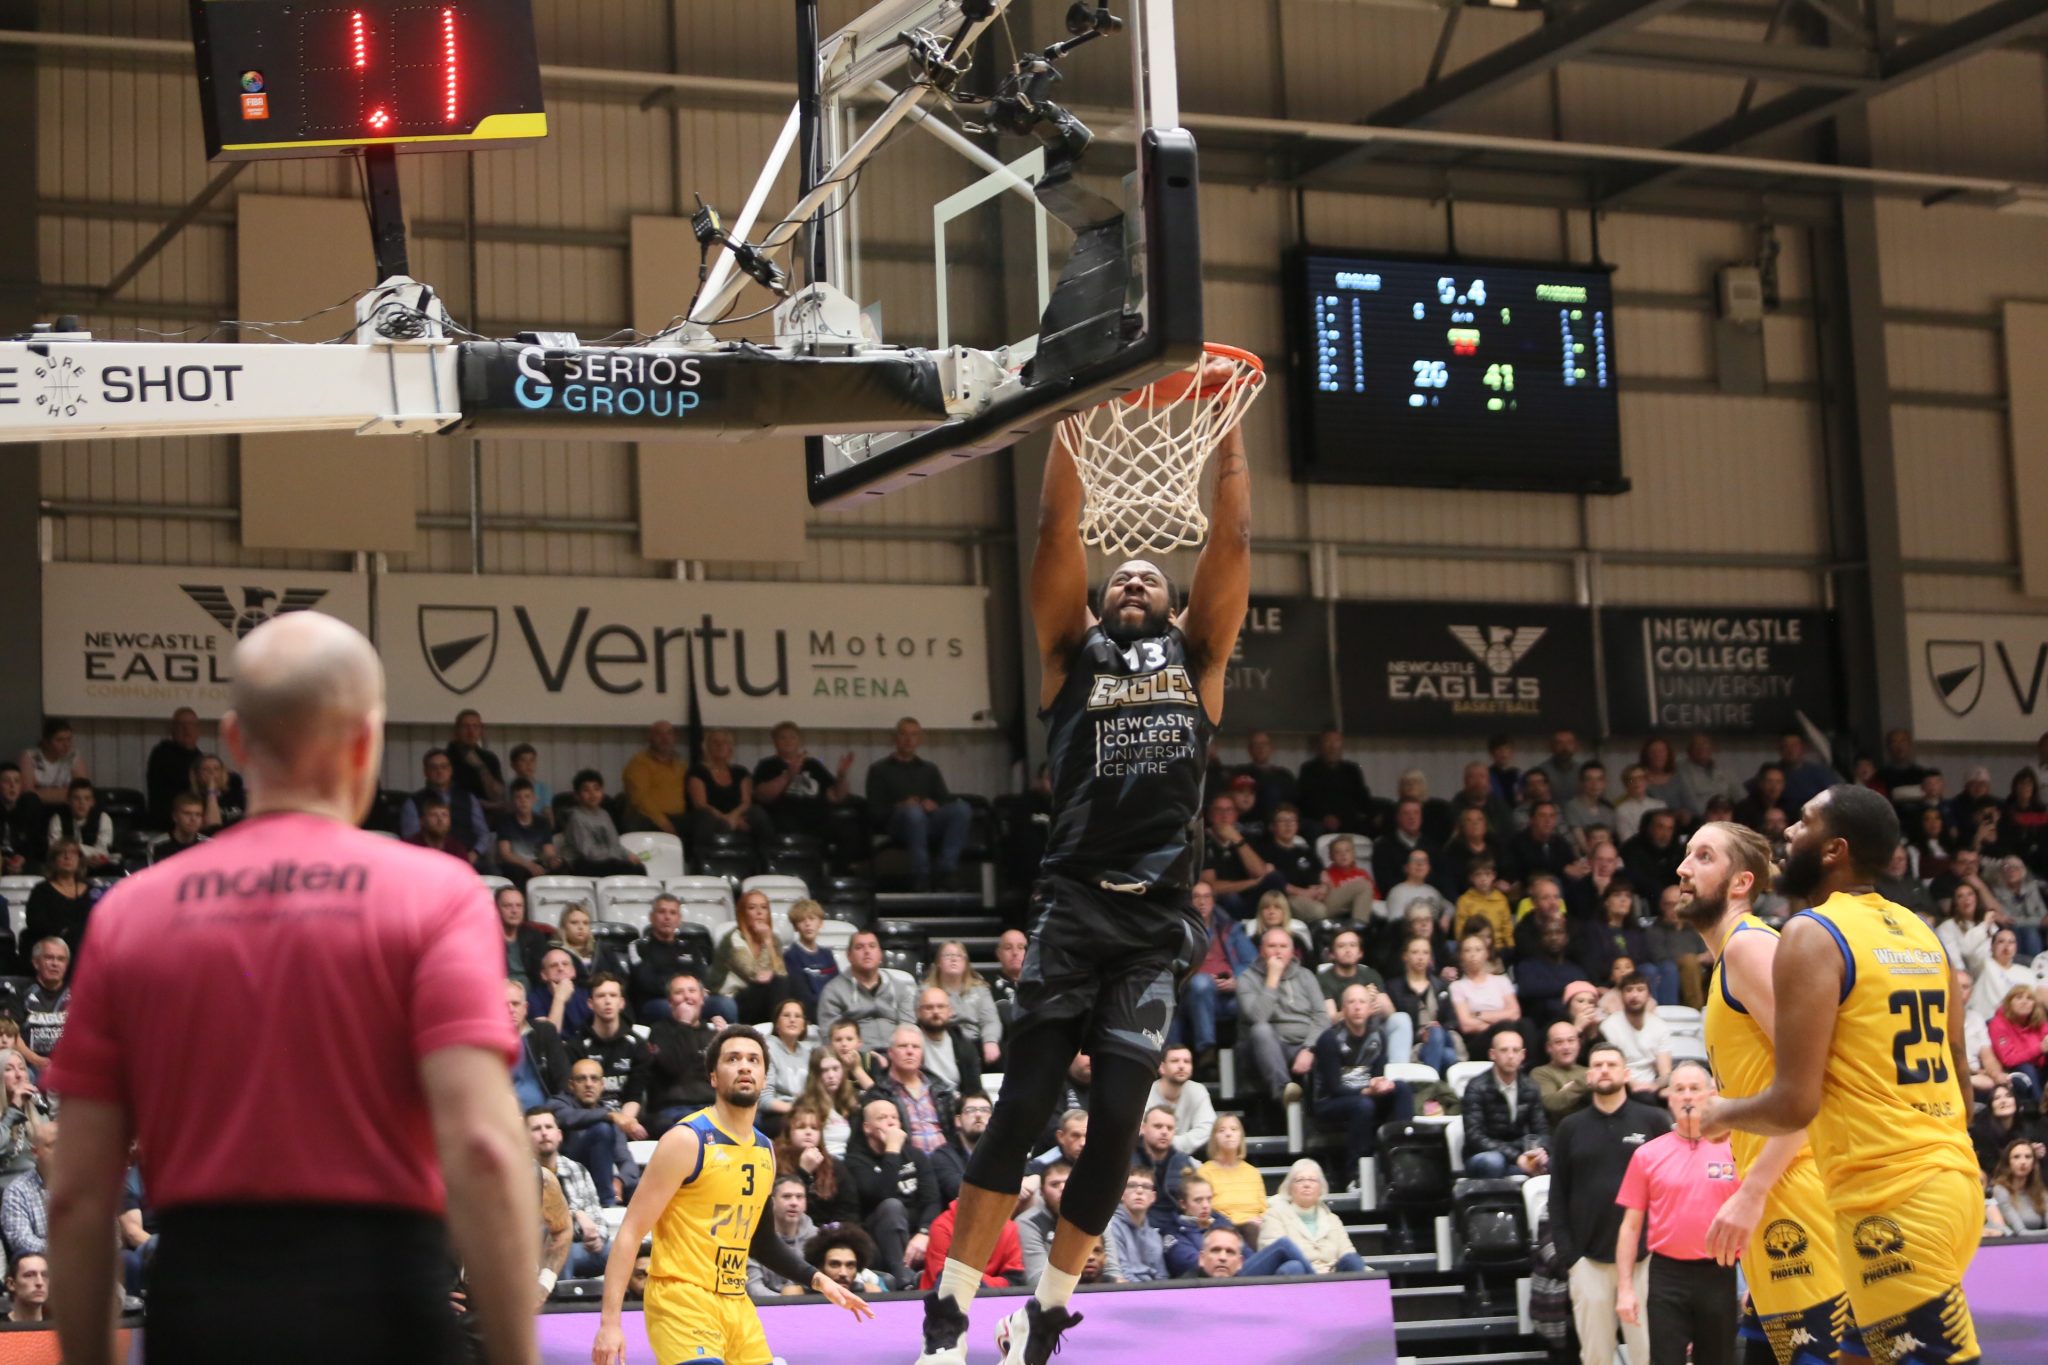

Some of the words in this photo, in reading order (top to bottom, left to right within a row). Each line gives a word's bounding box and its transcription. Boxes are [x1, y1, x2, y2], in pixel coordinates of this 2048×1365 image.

[35, 356, 86, 378] SURE
[101, 364, 244, 402] SHOT
[35, 394, 88, 417] SHOT
[562, 384, 700, 418] GROUP
[84, 631, 217, 650] NEWCASTLE
[1653, 617, 1803, 642] NEWCASTLE
[513, 604, 790, 697] Vertu
[808, 630, 963, 658] Motors
[84, 651, 236, 684] EAGL
[1122, 641, 1168, 671] 13
[1387, 661, 1476, 674] NEWCASTLE
[1655, 646, 1769, 669] COLLEGE
[812, 676, 911, 697] ARENA
[1389, 674, 1541, 699] EAGLES
[1658, 674, 1795, 697] UNIVERSITY
[1453, 700, 1539, 713] BASKETBALL
[1661, 703, 1754, 725] CENTRE
[1104, 729, 1181, 747] COLLEGE
[1104, 745, 1196, 762] UNIVERSITY
[1102, 761, 1168, 777] CENTRE
[176, 859, 369, 904] molten
[1889, 989, 1949, 1085] 25
[741, 1163, 755, 1196] 3
[1770, 1264, 1812, 1281] PHOENIX
[1863, 1261, 1914, 1285] PHOENIX
